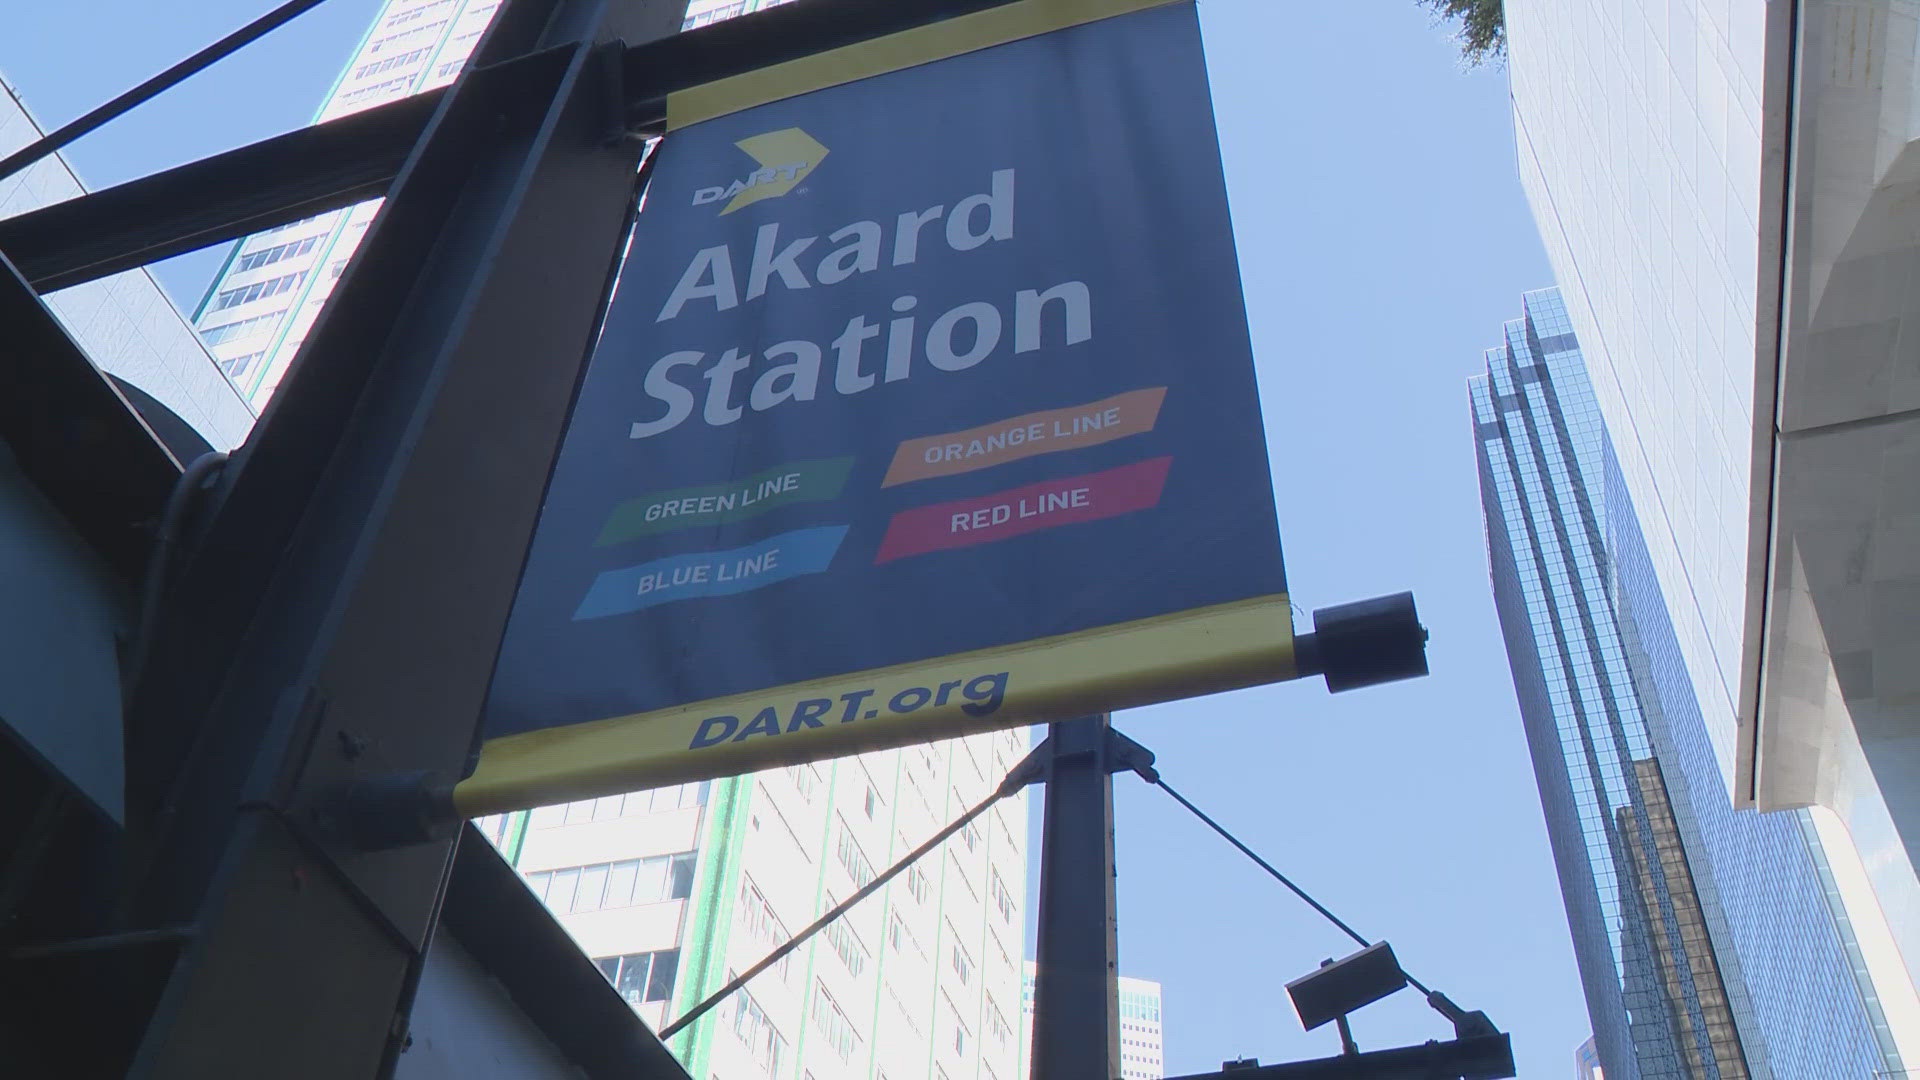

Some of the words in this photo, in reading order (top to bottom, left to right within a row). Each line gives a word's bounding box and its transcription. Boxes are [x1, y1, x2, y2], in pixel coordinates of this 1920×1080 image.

[692, 161, 808, 206] DART
[656, 168, 1015, 323] Akard
[629, 281, 1092, 439] Station
[924, 422, 1045, 464] ORANGE
[1054, 407, 1121, 438] LINE
[644, 492, 737, 523] GREEN
[742, 472, 801, 507] LINE
[950, 504, 1012, 533] RED
[1019, 487, 1091, 518] LINE
[637, 564, 709, 596] BLUE
[717, 549, 780, 583] LINE
[689, 671, 1010, 750] DART.org
